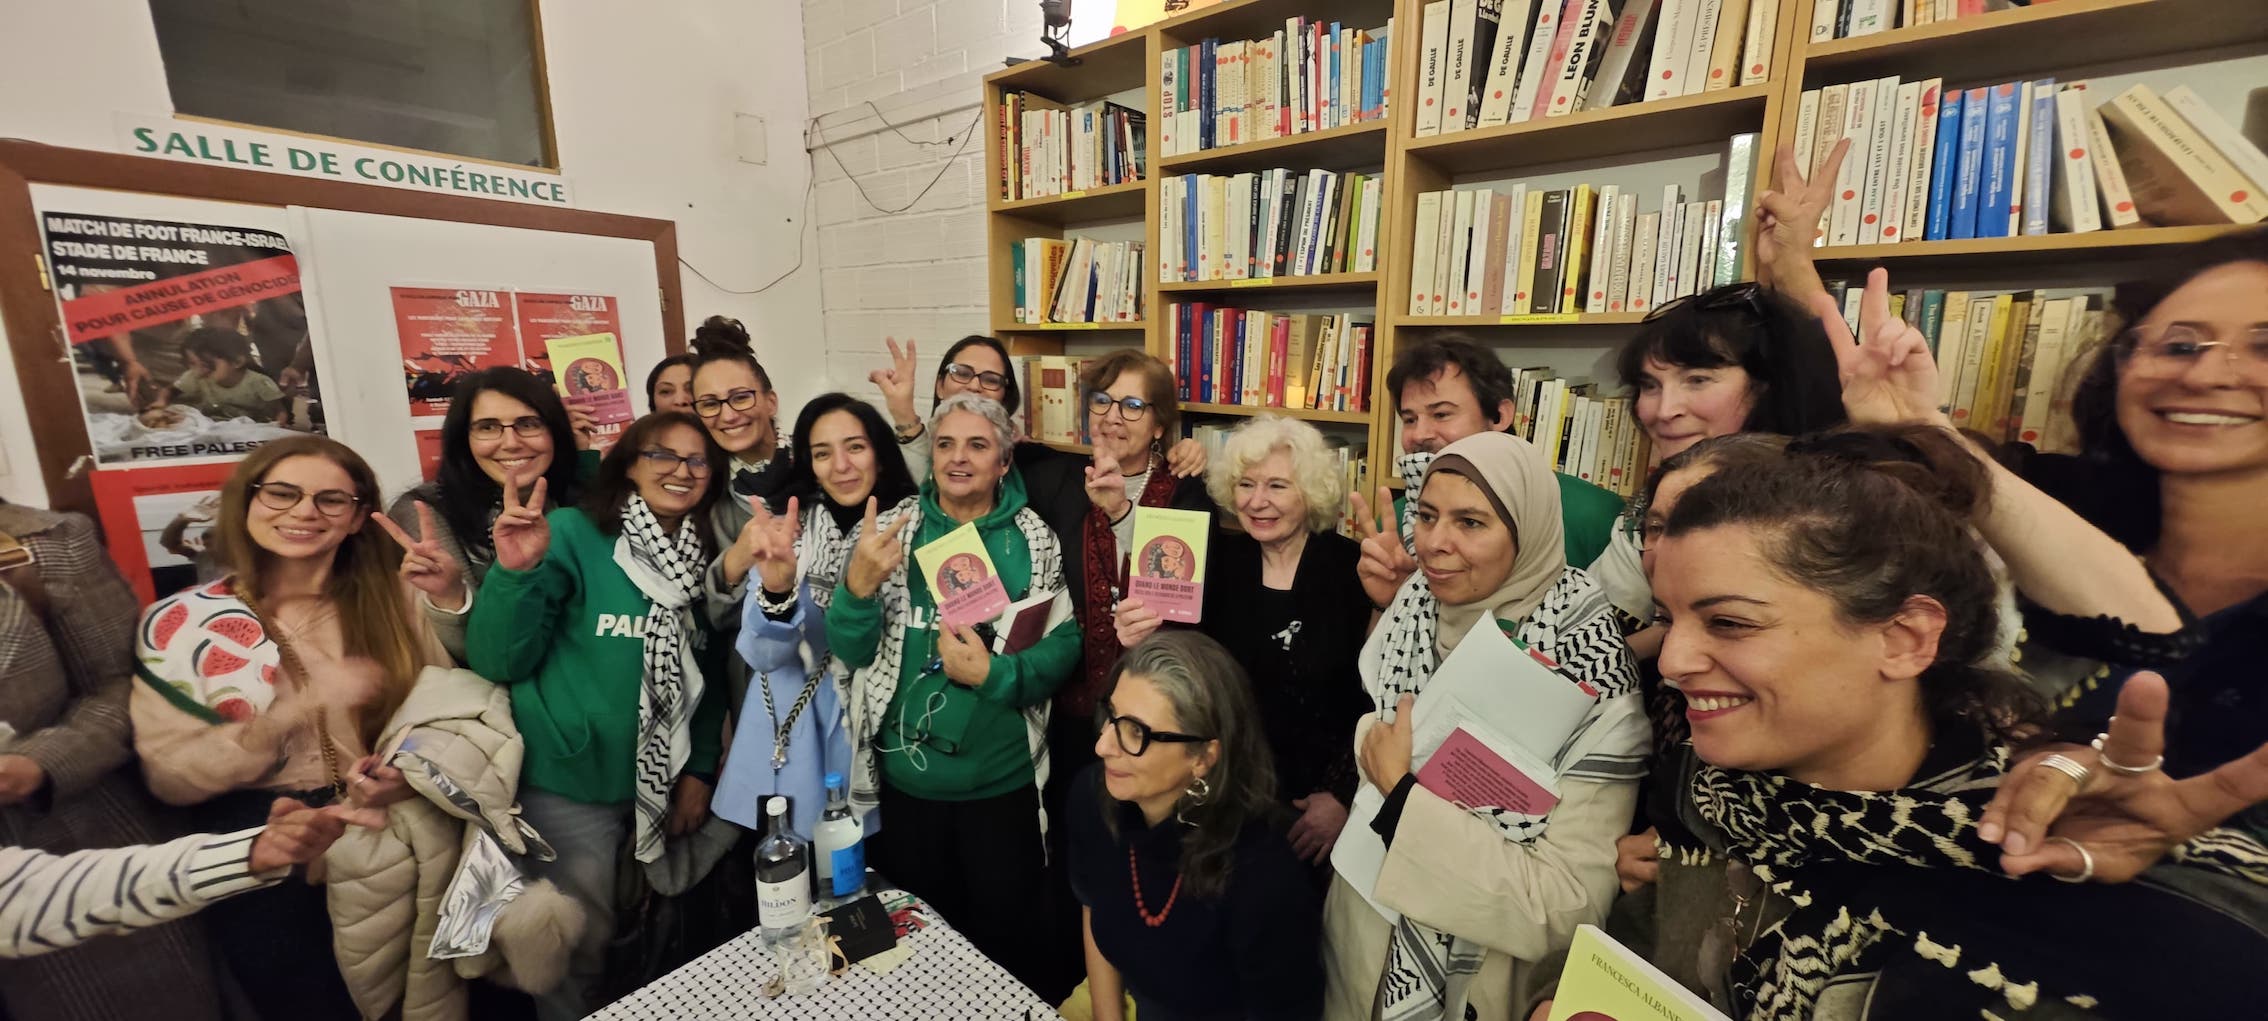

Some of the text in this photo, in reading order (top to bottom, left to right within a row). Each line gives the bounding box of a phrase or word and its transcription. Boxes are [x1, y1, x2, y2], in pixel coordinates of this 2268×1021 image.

[1428, 48, 1437, 87] DE GAULLE
[1454, 38, 1464, 80] DE GAULLE
[1499, 35, 1514, 76] DE GAULLE
[1564, 42, 1585, 80] LEON
[1162, 90, 1173, 118] STOP
[1872, 169, 1881, 186] ENTRE
[1877, 120, 1887, 144] L'OUEST
[1897, 143, 1905, 156] sous
[134, 126, 567, 203] SALLE DE CONFÉRENCE
[1894, 157, 1904, 177] société
[47, 218, 107, 236] MATCH
[110, 223, 134, 238] DE
[136, 224, 178, 242] FOOT
[53, 242, 209, 265] STADE DE FRANCE
[58, 266, 156, 280] 14 novembre
[125, 272, 241, 305] ANNULATION
[456, 291, 500, 308] GAZA
[75, 274, 301, 333] POUR CAUSE DE GÉNOCIDE
[570, 295, 608, 312] GAZA
[132, 441, 189, 458] FREE
[1135, 581, 1152, 589] QUAND
[1161, 583, 1179, 591] MONDE
[1180, 585, 1194, 593] DORT
[760, 896, 797, 909] HILDON
[1592, 953, 1640, 997] FRANCESCA
